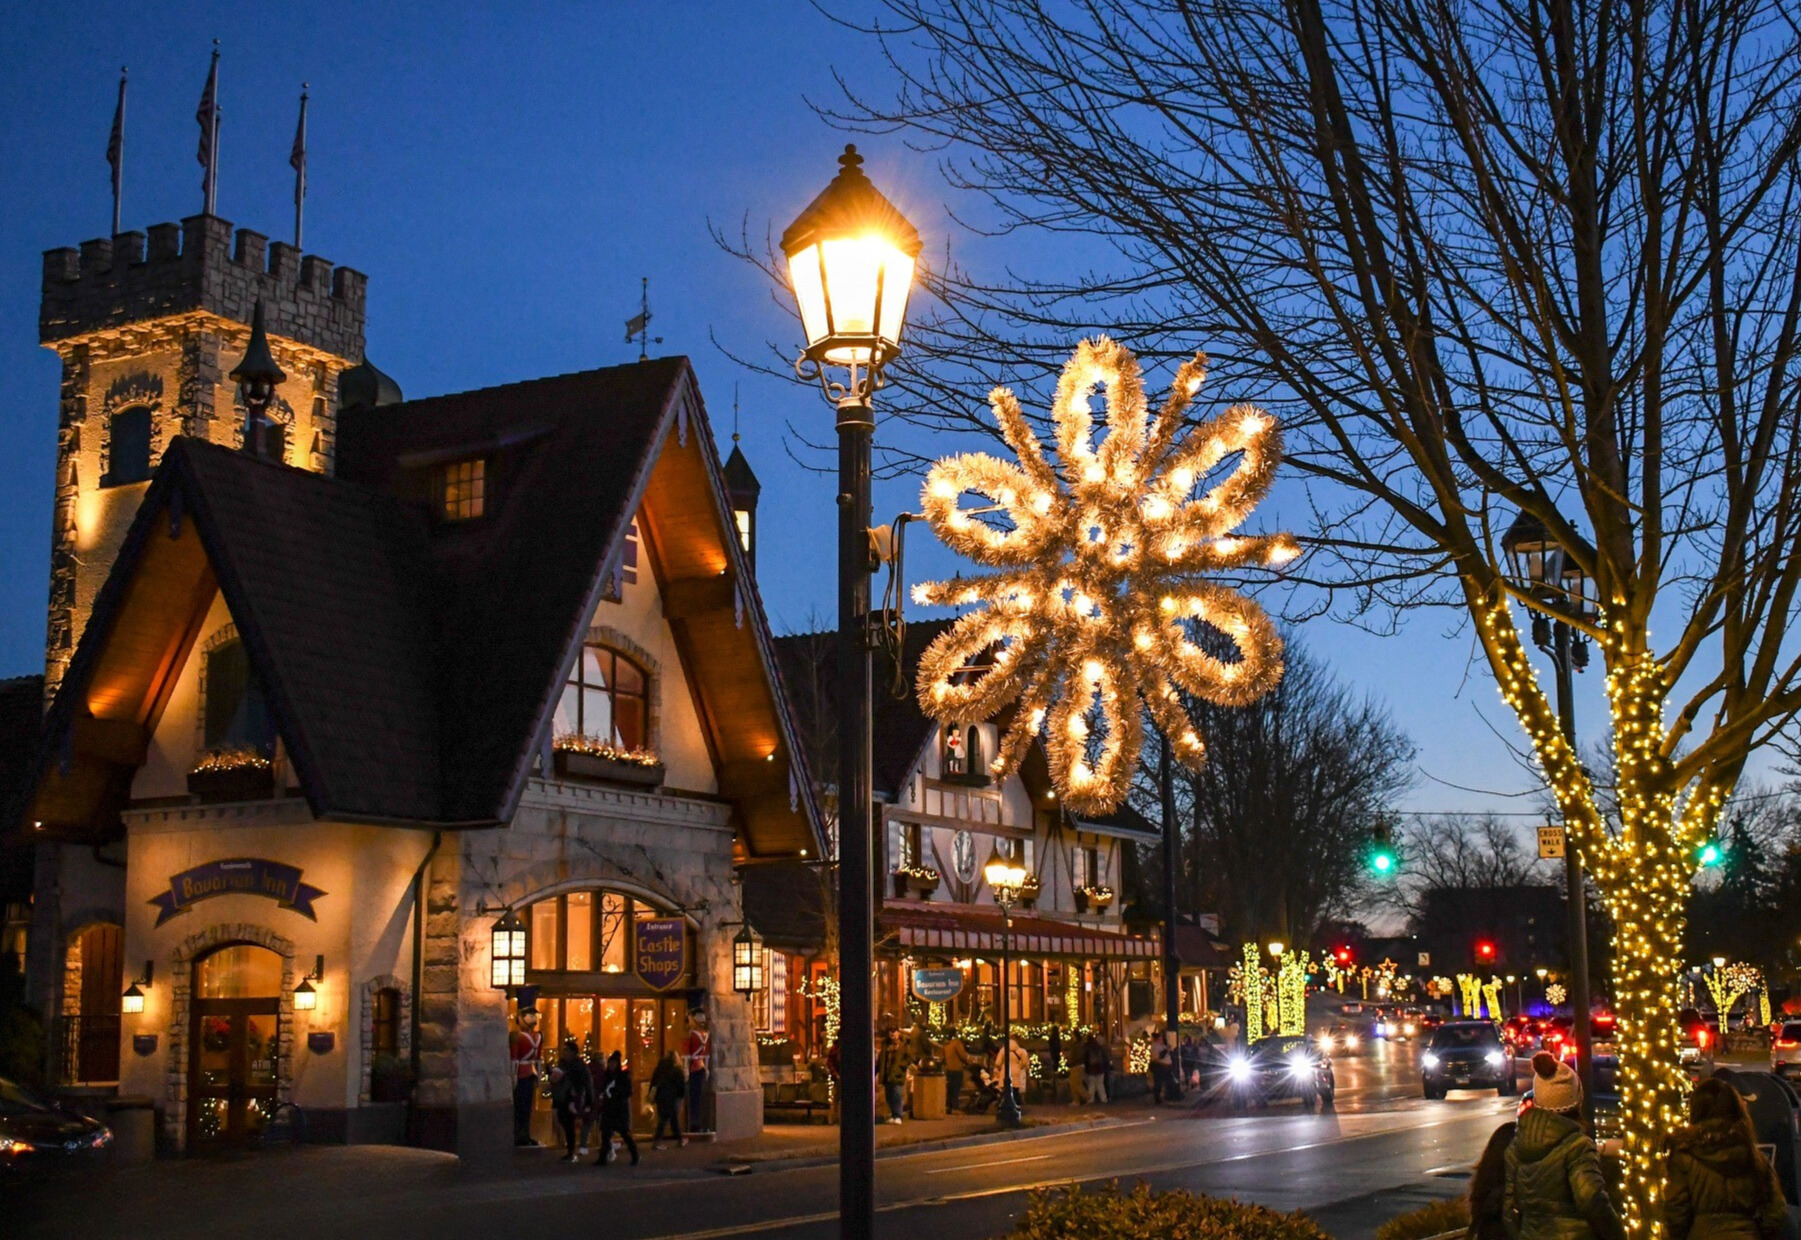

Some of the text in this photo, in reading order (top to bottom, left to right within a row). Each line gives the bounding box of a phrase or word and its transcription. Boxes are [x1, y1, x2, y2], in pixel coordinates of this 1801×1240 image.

[1539, 829, 1563, 837] CROSS
[1541, 838, 1561, 846] WALK
[182, 868, 288, 899] Bavarian Inn
[639, 935, 680, 953] Castle
[639, 956, 679, 976] Shops
